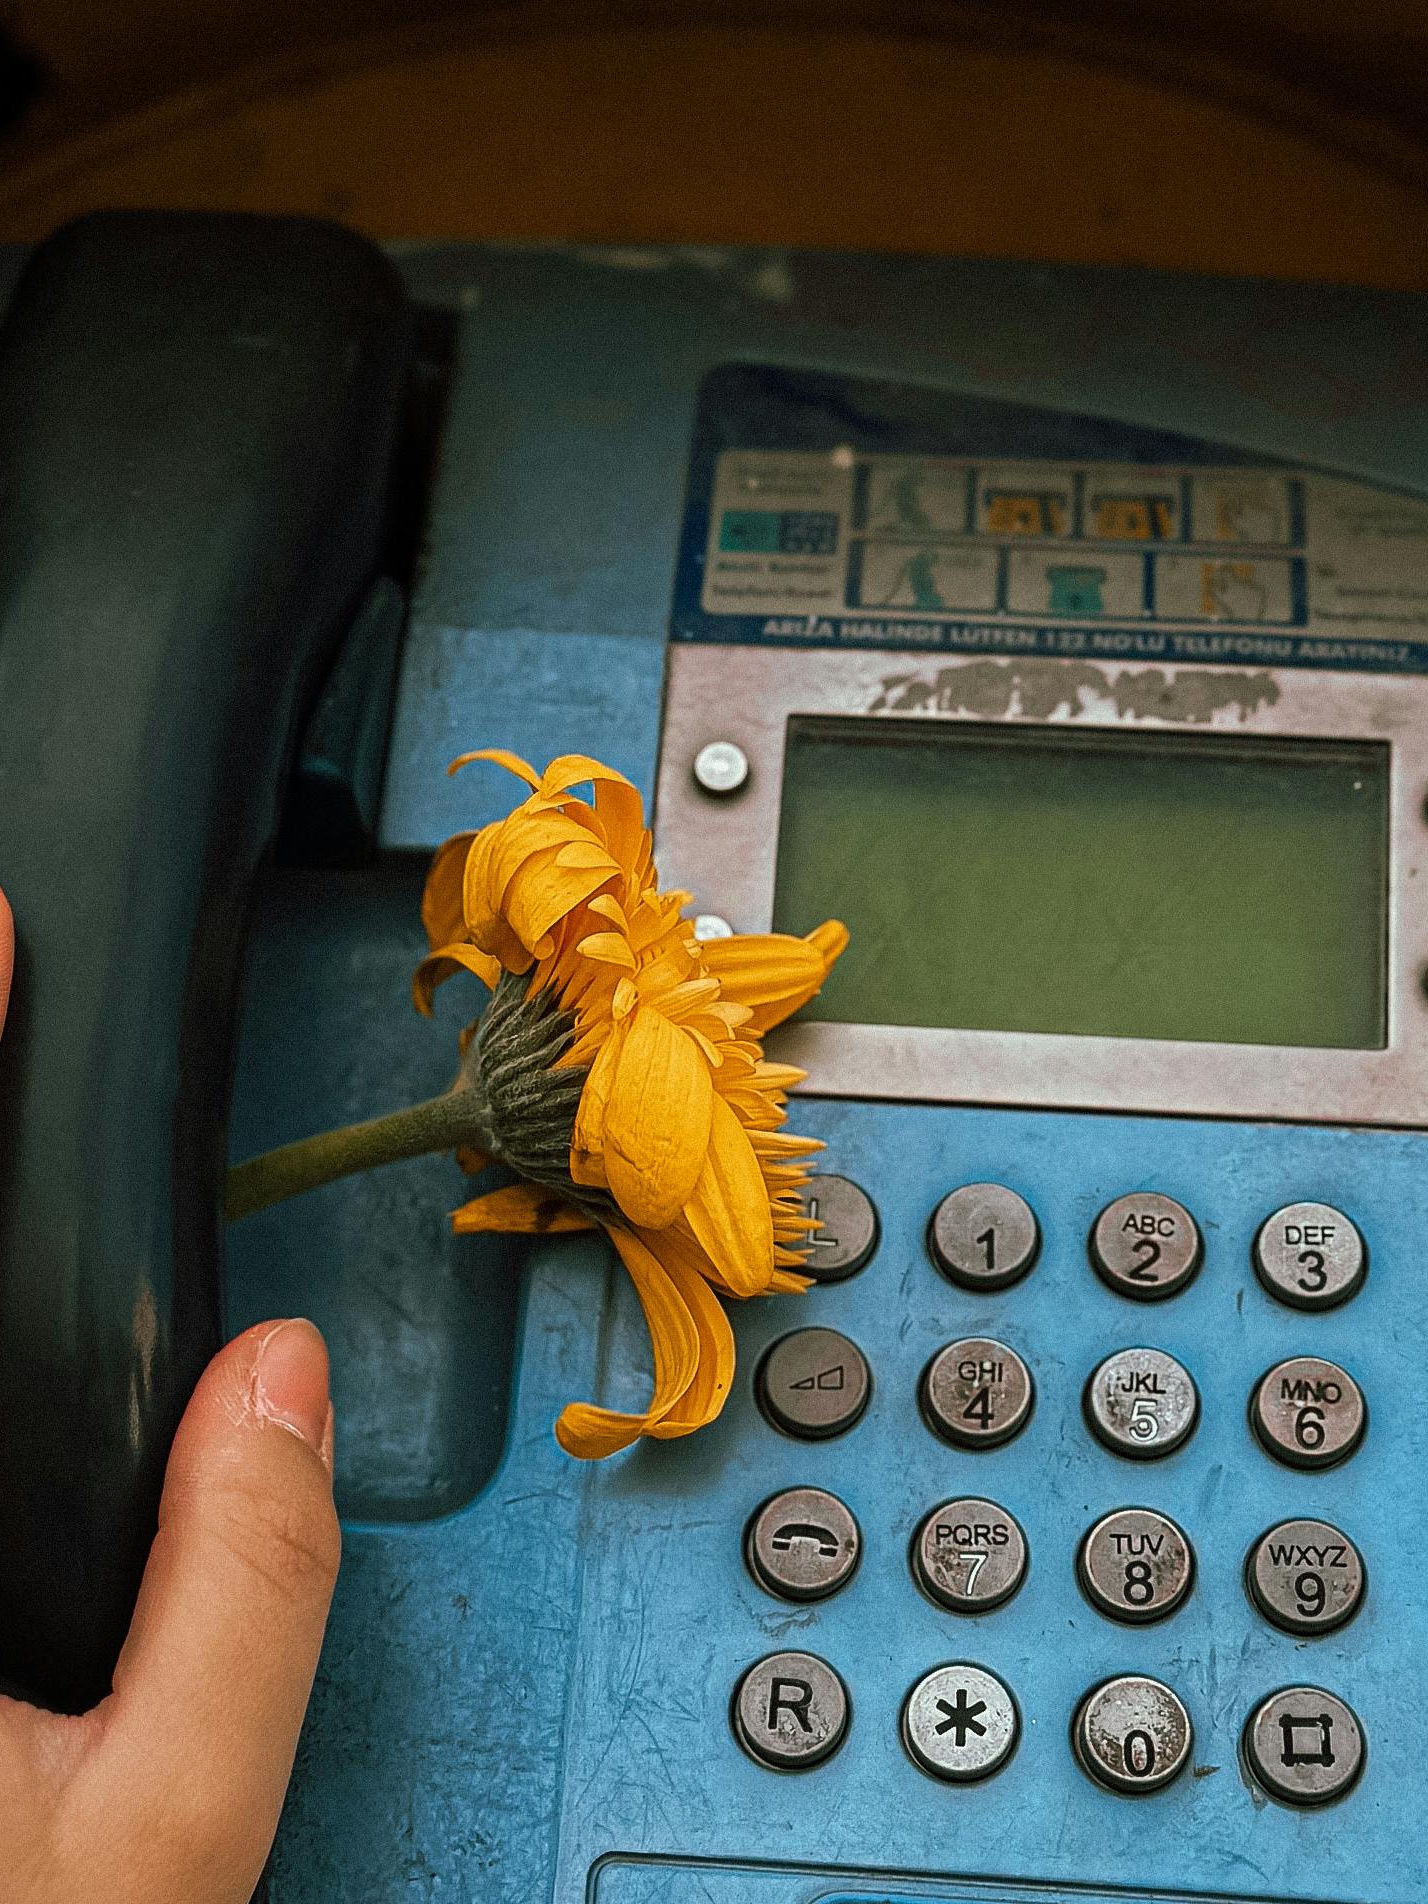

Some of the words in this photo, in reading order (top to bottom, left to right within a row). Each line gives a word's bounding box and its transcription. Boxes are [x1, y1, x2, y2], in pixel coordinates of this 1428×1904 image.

[1122, 1212, 1176, 1238] ABC
[1285, 1224, 1335, 1247] DEF
[975, 1227, 996, 1271] 1
[1132, 1239, 1161, 1282] 2
[1297, 1250, 1328, 1293] 3
[957, 1360, 1004, 1383] GHI
[1121, 1372, 1167, 1396] JKL
[1280, 1380, 1343, 1406] MNO
[962, 1385, 995, 1430] 4
[1129, 1398, 1159, 1443] 5
[1294, 1407, 1326, 1451] 6
[935, 1523, 1010, 1549] PQRS
[1110, 1532, 1164, 1557] TUV
[1268, 1543, 1348, 1569] WXYZ
[958, 1552, 989, 1597] 7
[1123, 1560, 1155, 1606] 8
[1295, 1571, 1326, 1618] 9
[767, 1677, 814, 1734] R
[1123, 1729, 1155, 1778] 0
